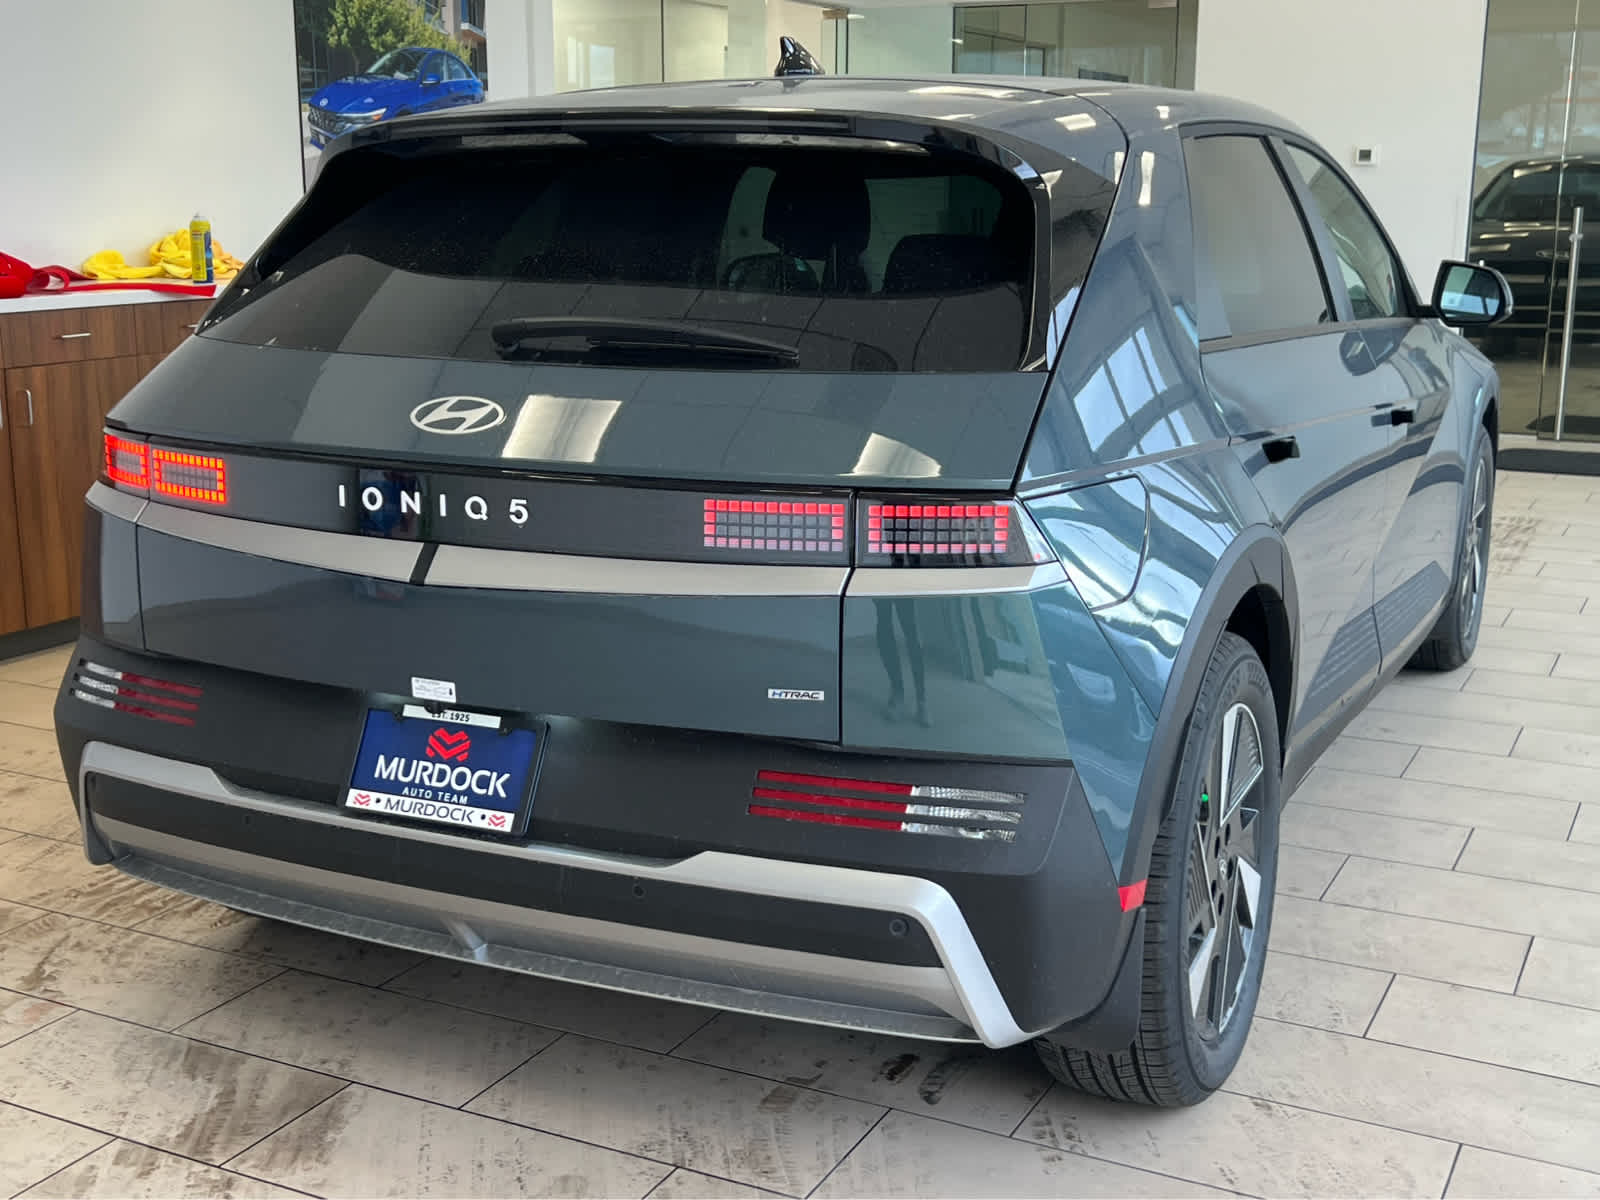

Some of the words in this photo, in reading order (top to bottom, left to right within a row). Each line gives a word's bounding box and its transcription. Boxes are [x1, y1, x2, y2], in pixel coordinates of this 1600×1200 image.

[338, 484, 488, 521] IONIQ
[509, 498, 529, 524] 5
[771, 690, 820, 699] HTRAC
[450, 712, 471, 722] 1925
[374, 754, 510, 798] MURDOCK
[402, 786, 433, 799] AUTO
[437, 791, 468, 804] TEAM
[384, 797, 475, 823] MURDOCK
